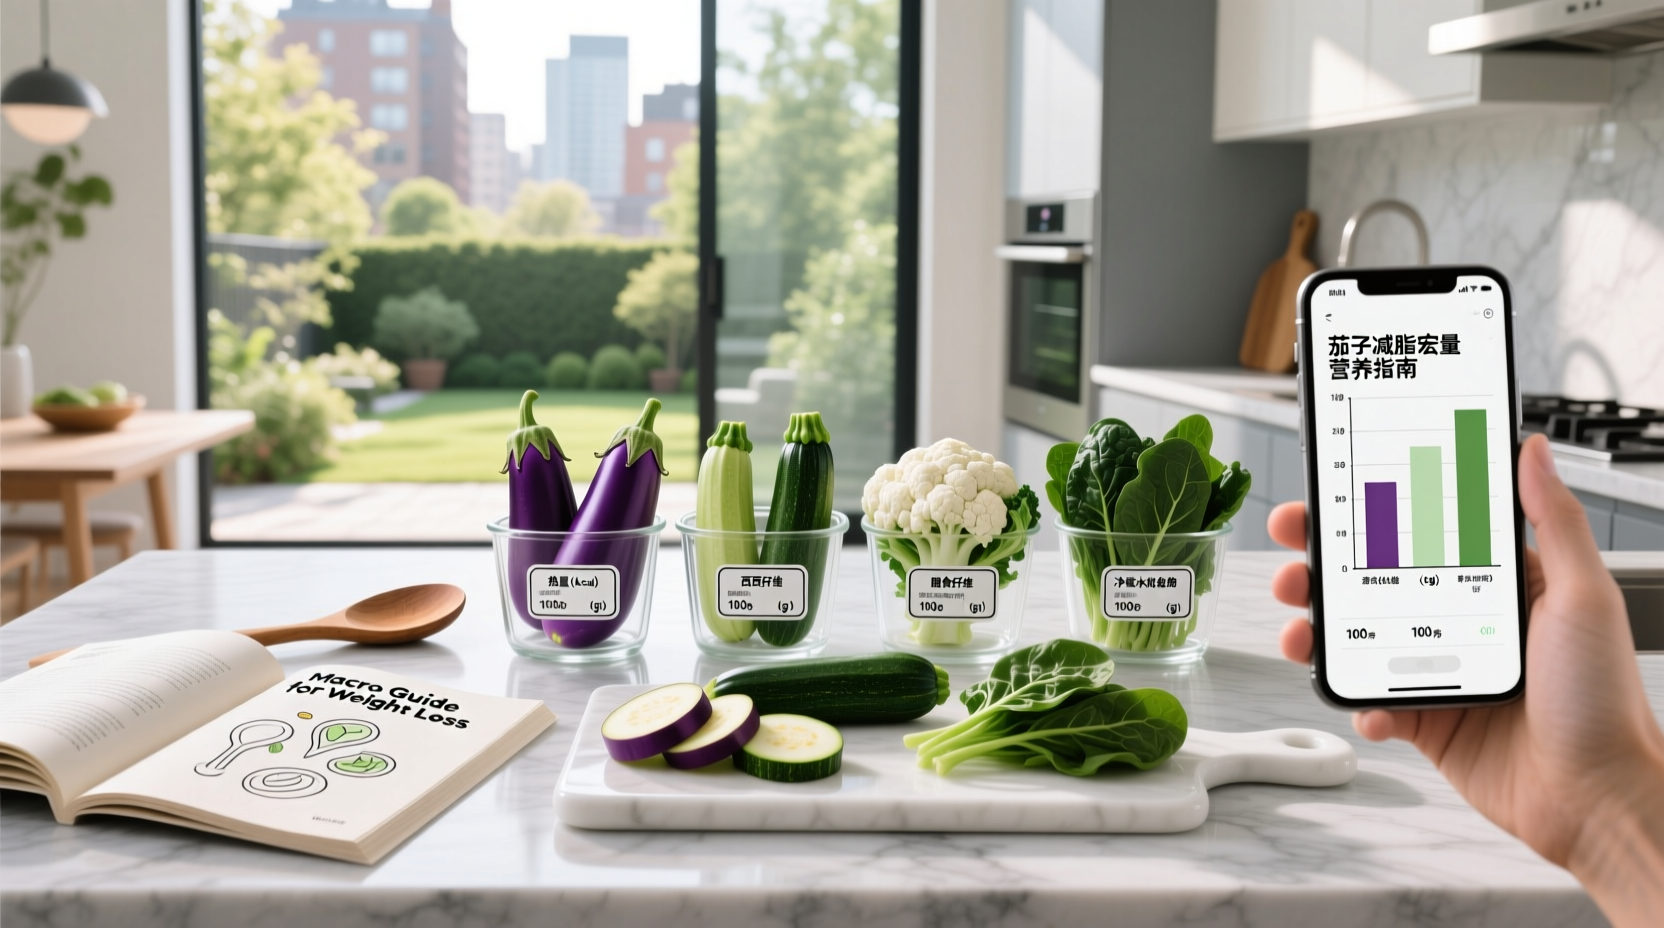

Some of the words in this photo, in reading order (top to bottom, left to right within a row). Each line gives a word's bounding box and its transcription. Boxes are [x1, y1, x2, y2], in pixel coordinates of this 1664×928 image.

[1328, 333, 1461, 356] 茄子减脂宏量
[1329, 356, 1418, 380] 营养指南
[286, 681, 325, 694] for
[328, 686, 411, 715] Weight
[414, 707, 470, 729] Loss
[308, 672, 383, 693] Macro
[389, 686, 460, 713] Guide
